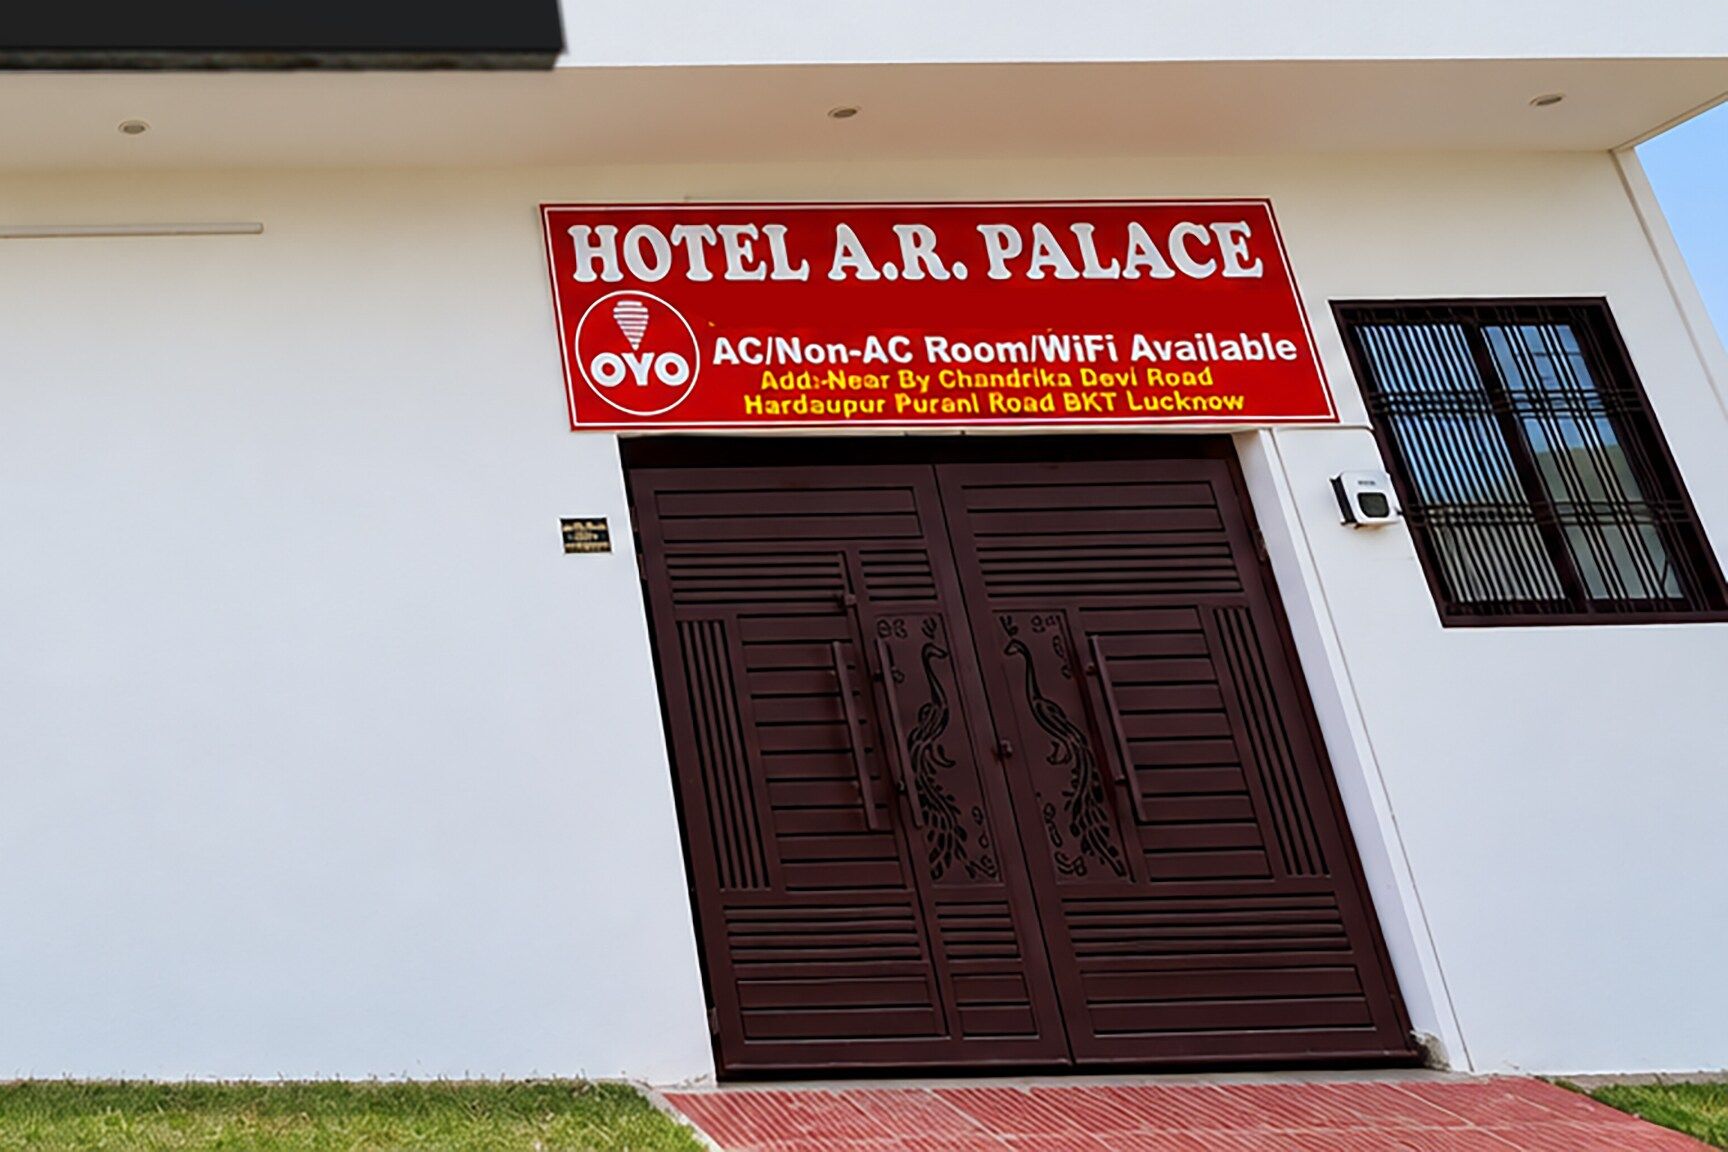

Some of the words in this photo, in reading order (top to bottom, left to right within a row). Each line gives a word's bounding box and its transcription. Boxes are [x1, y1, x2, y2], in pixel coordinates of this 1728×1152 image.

[567, 222, 810, 283] HOTEL
[828, 222, 969, 282] A.R.
[976, 220, 1264, 280] PALACE
[712, 335, 914, 366] AC/Non-AC
[923, 333, 1119, 364] Room/WiFi
[1130, 331, 1298, 362] Available
[590, 351, 690, 388] OYO
[897, 368, 931, 394] By
[938, 367, 1073, 389] Chandrika
[1080, 366, 1139, 388] Devi
[1146, 365, 1215, 387] Road
[743, 393, 887, 419] Hardaupur
[894, 392, 980, 415] Purani
[988, 391, 1056, 414] Road
[1063, 391, 1118, 413] BKT
[1125, 389, 1245, 412] Lucknow
